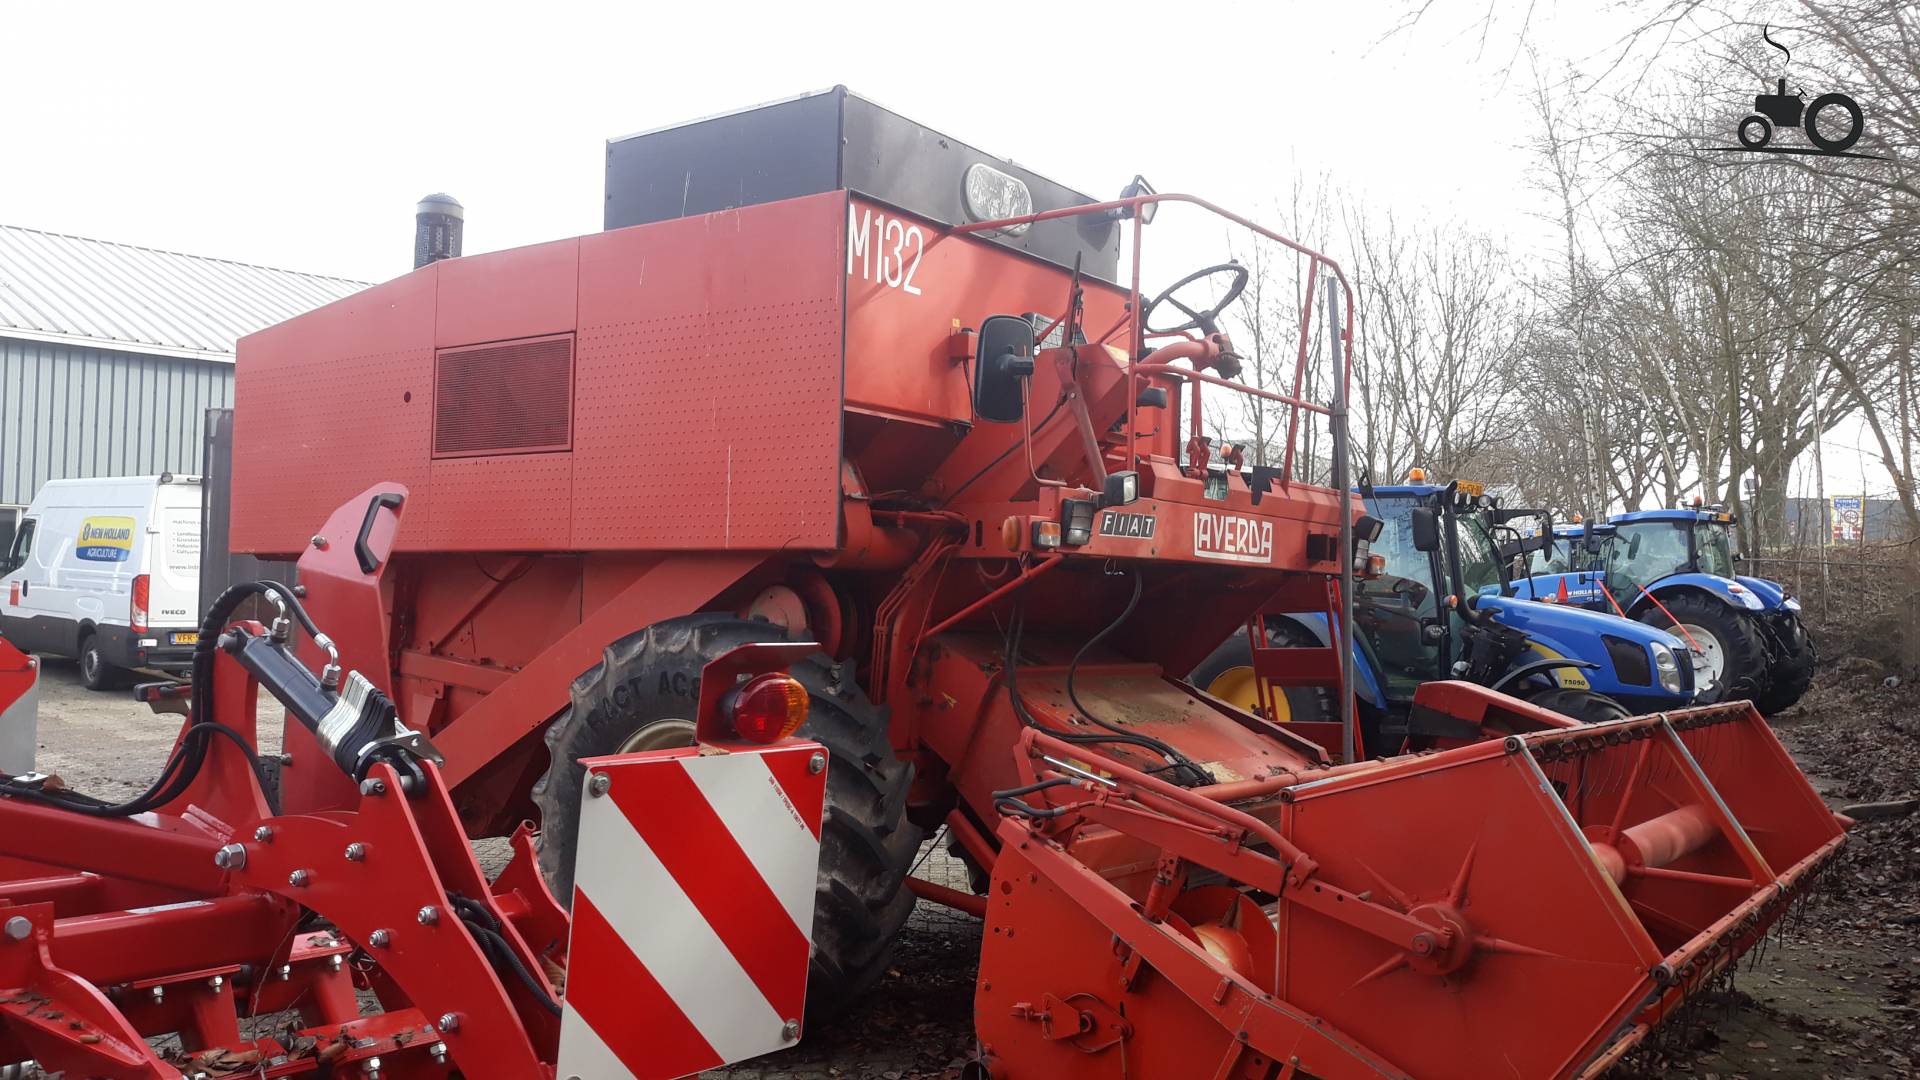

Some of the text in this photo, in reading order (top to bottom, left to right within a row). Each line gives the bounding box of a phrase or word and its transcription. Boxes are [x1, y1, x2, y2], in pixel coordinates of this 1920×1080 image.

[848, 204, 923, 296] M132
[90, 527, 130, 540] NEW HOLLAND
[1103, 514, 1153, 535] FIAT
[1194, 512, 1272, 563] LAVERDA
[87, 547, 117, 558] AGRICULTURE
